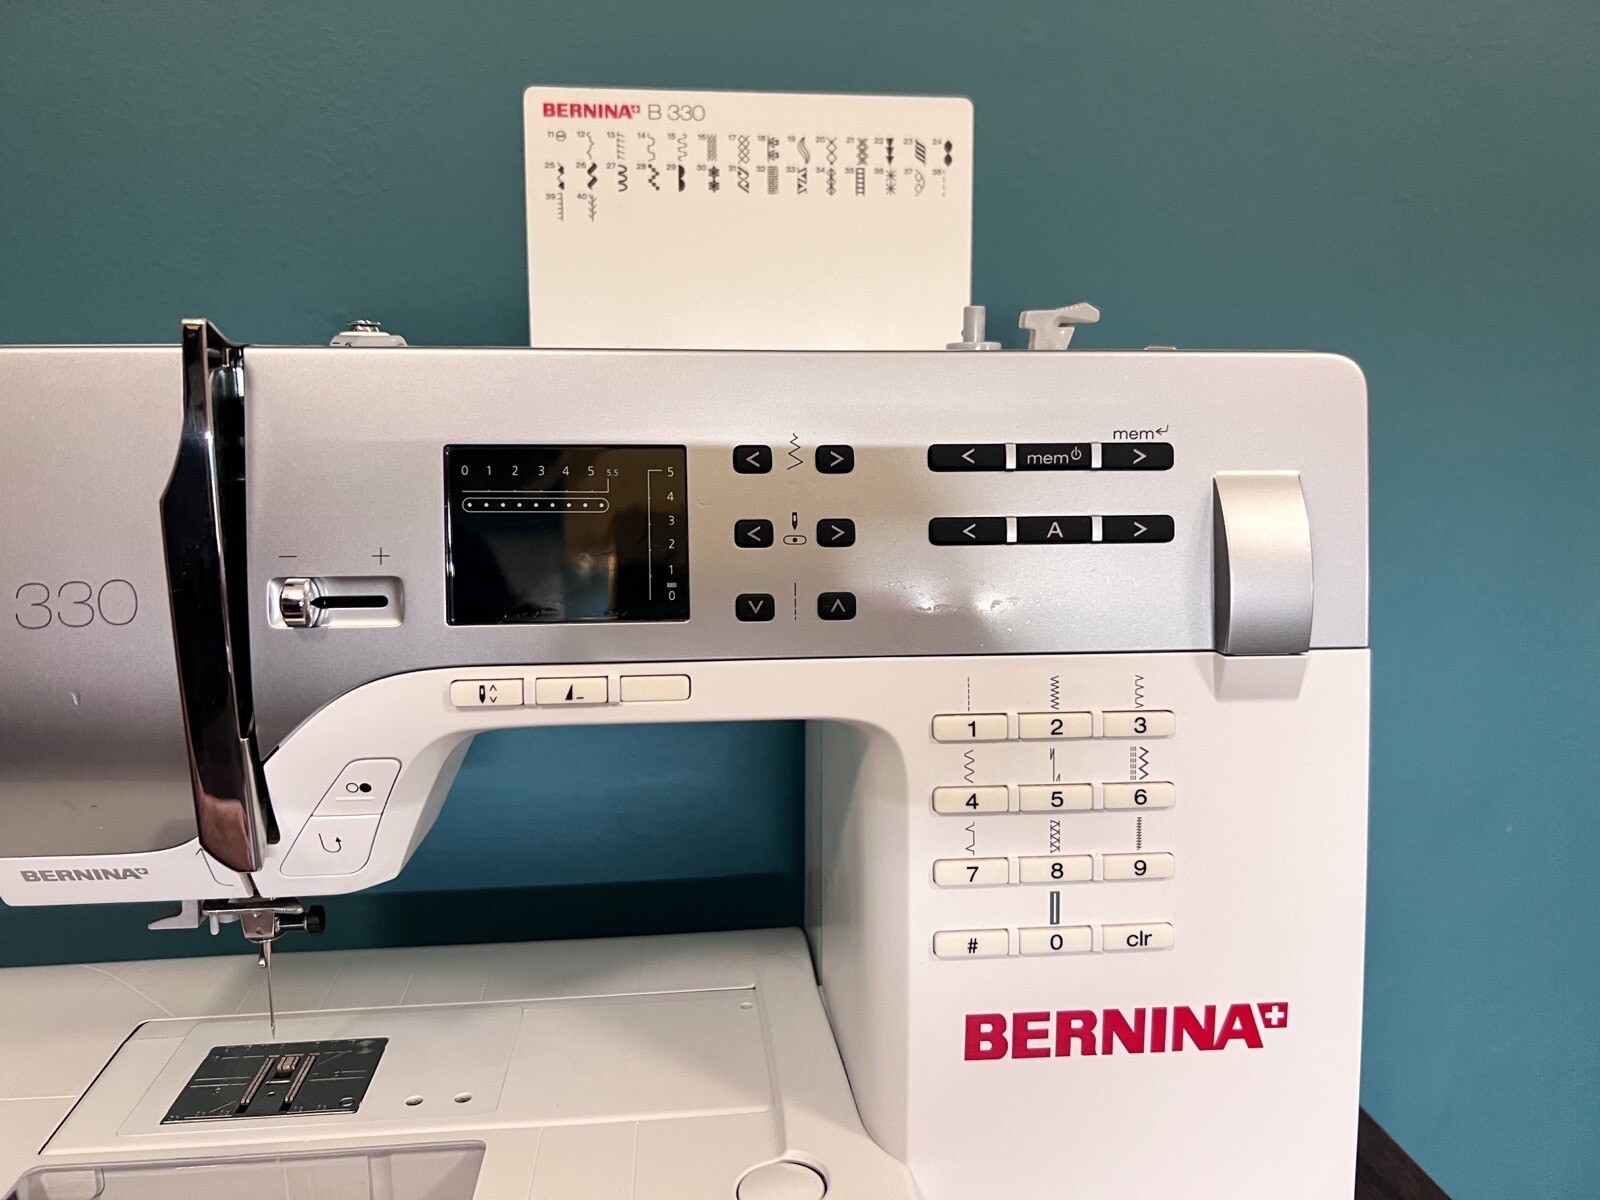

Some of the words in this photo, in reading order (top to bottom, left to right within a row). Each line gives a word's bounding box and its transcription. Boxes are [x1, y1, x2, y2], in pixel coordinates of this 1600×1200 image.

[543, 102, 633, 119] BERNINA
[648, 104, 661, 120] B
[667, 105, 706, 121] 330
[1113, 429, 1155, 440] mem
[1027, 452, 1069, 464] mem
[461, 466, 469, 476] 0
[487, 466, 492, 476] 1
[512, 466, 519, 476] 2
[538, 466, 545, 476] 3
[562, 466, 570, 476] 4
[588, 466, 595, 476] 5
[606, 469, 619, 477] 5.5
[667, 467, 675, 477] 5
[667, 492, 674, 501] 4
[668, 516, 675, 526] 3
[1046, 522, 1064, 539] A
[668, 539, 675, 549] 2
[669, 565, 674, 575] 1
[668, 590, 676, 601] 0
[16, 579, 138, 629] 330
[967, 720, 976, 737] 1
[1050, 718, 1063, 735] 2
[1134, 717, 1147, 734] 3
[965, 793, 979, 809] 4
[1051, 791, 1064, 807] 5
[1134, 789, 1147, 805] 6
[20, 868, 142, 882] BERNINA
[966, 866, 979, 882] 7
[1051, 862, 1064, 879] 8
[1134, 860, 1147, 876] 9
[1050, 934, 1063, 950] 0
[1126, 930, 1152, 947] clr
[965, 1003, 1264, 1060] BERNINA
